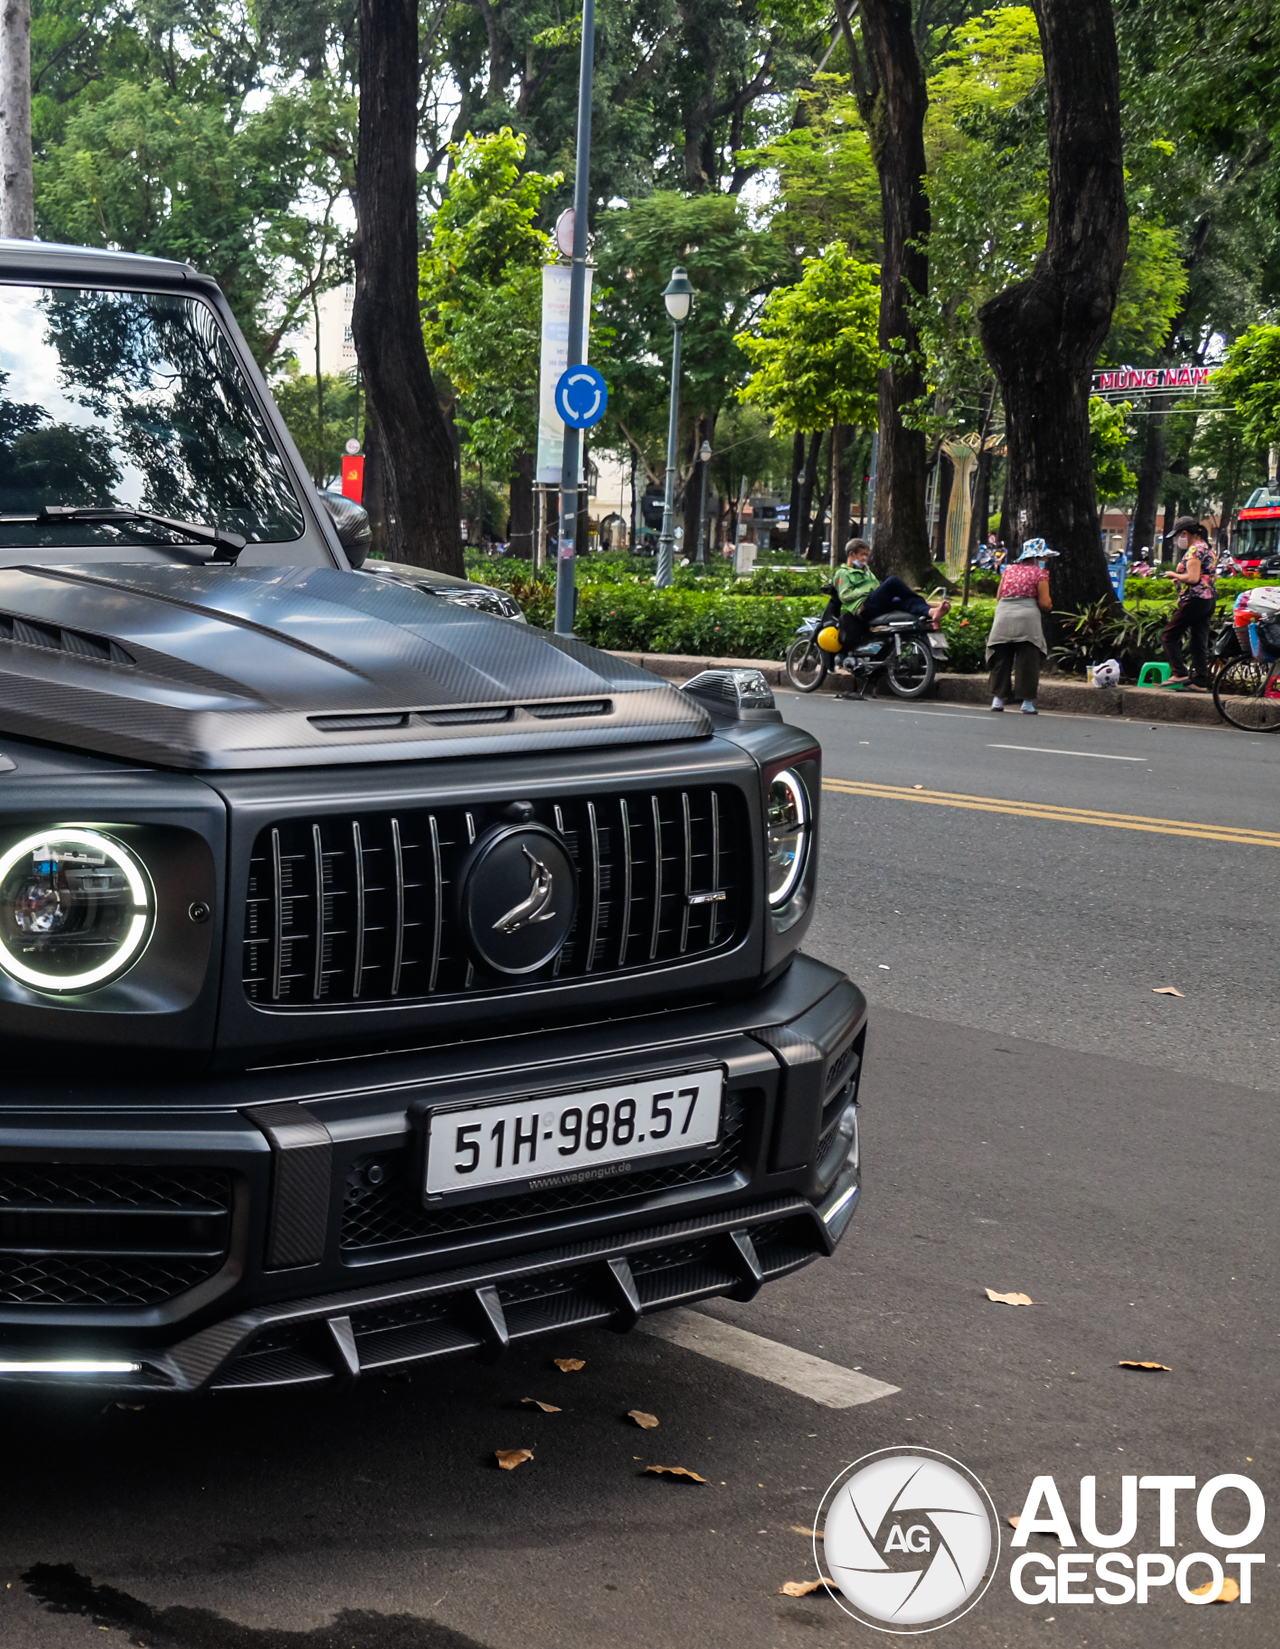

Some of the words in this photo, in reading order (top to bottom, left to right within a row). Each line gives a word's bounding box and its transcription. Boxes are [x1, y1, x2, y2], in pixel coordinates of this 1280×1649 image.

[1020, 509, 1027, 522] 5
[455, 1086, 700, 1174] 51H-988.57
[529, 1162, 632, 1190] www.wagengut.de
